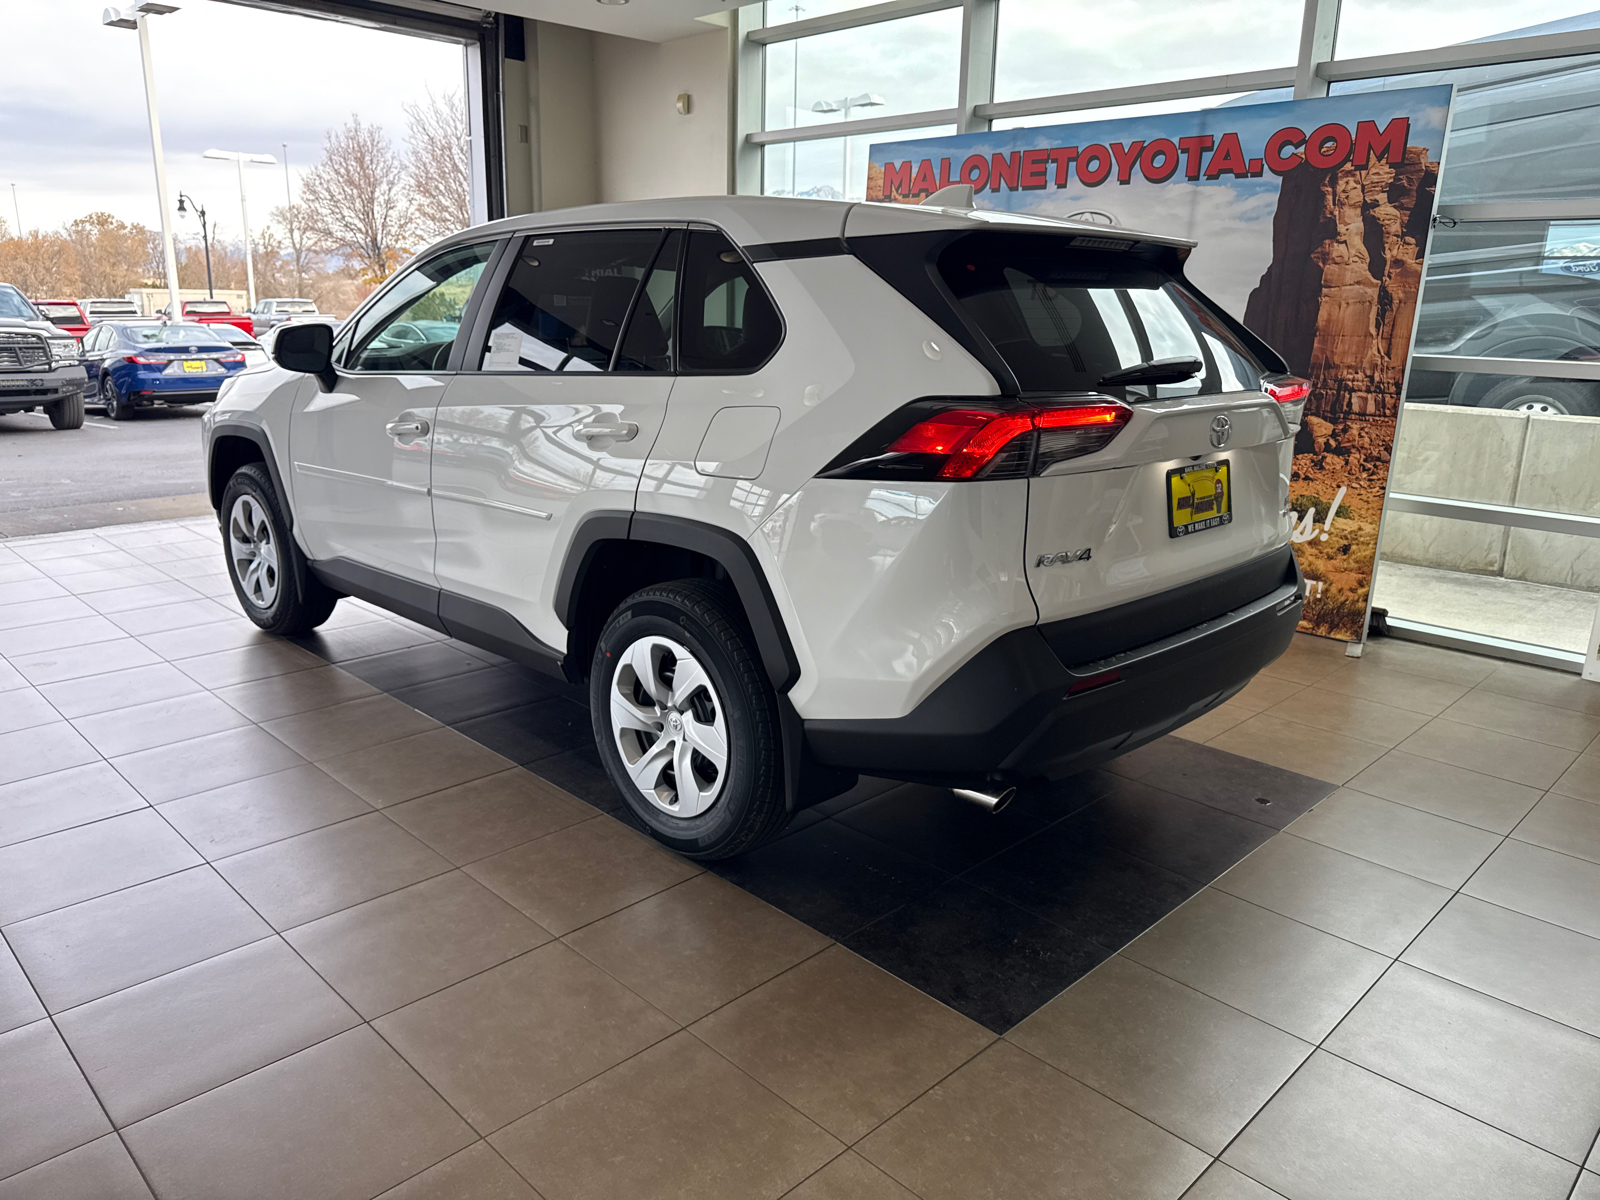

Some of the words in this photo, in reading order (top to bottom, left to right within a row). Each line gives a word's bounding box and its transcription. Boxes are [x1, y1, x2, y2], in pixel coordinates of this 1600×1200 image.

[883, 117, 1410, 199] MALONETOYOTA.COM
[1195, 522, 1206, 530] MAKE
[1206, 520, 1210, 528] IT
[1210, 517, 1220, 526] EASY
[1034, 547, 1092, 568] RAV4
